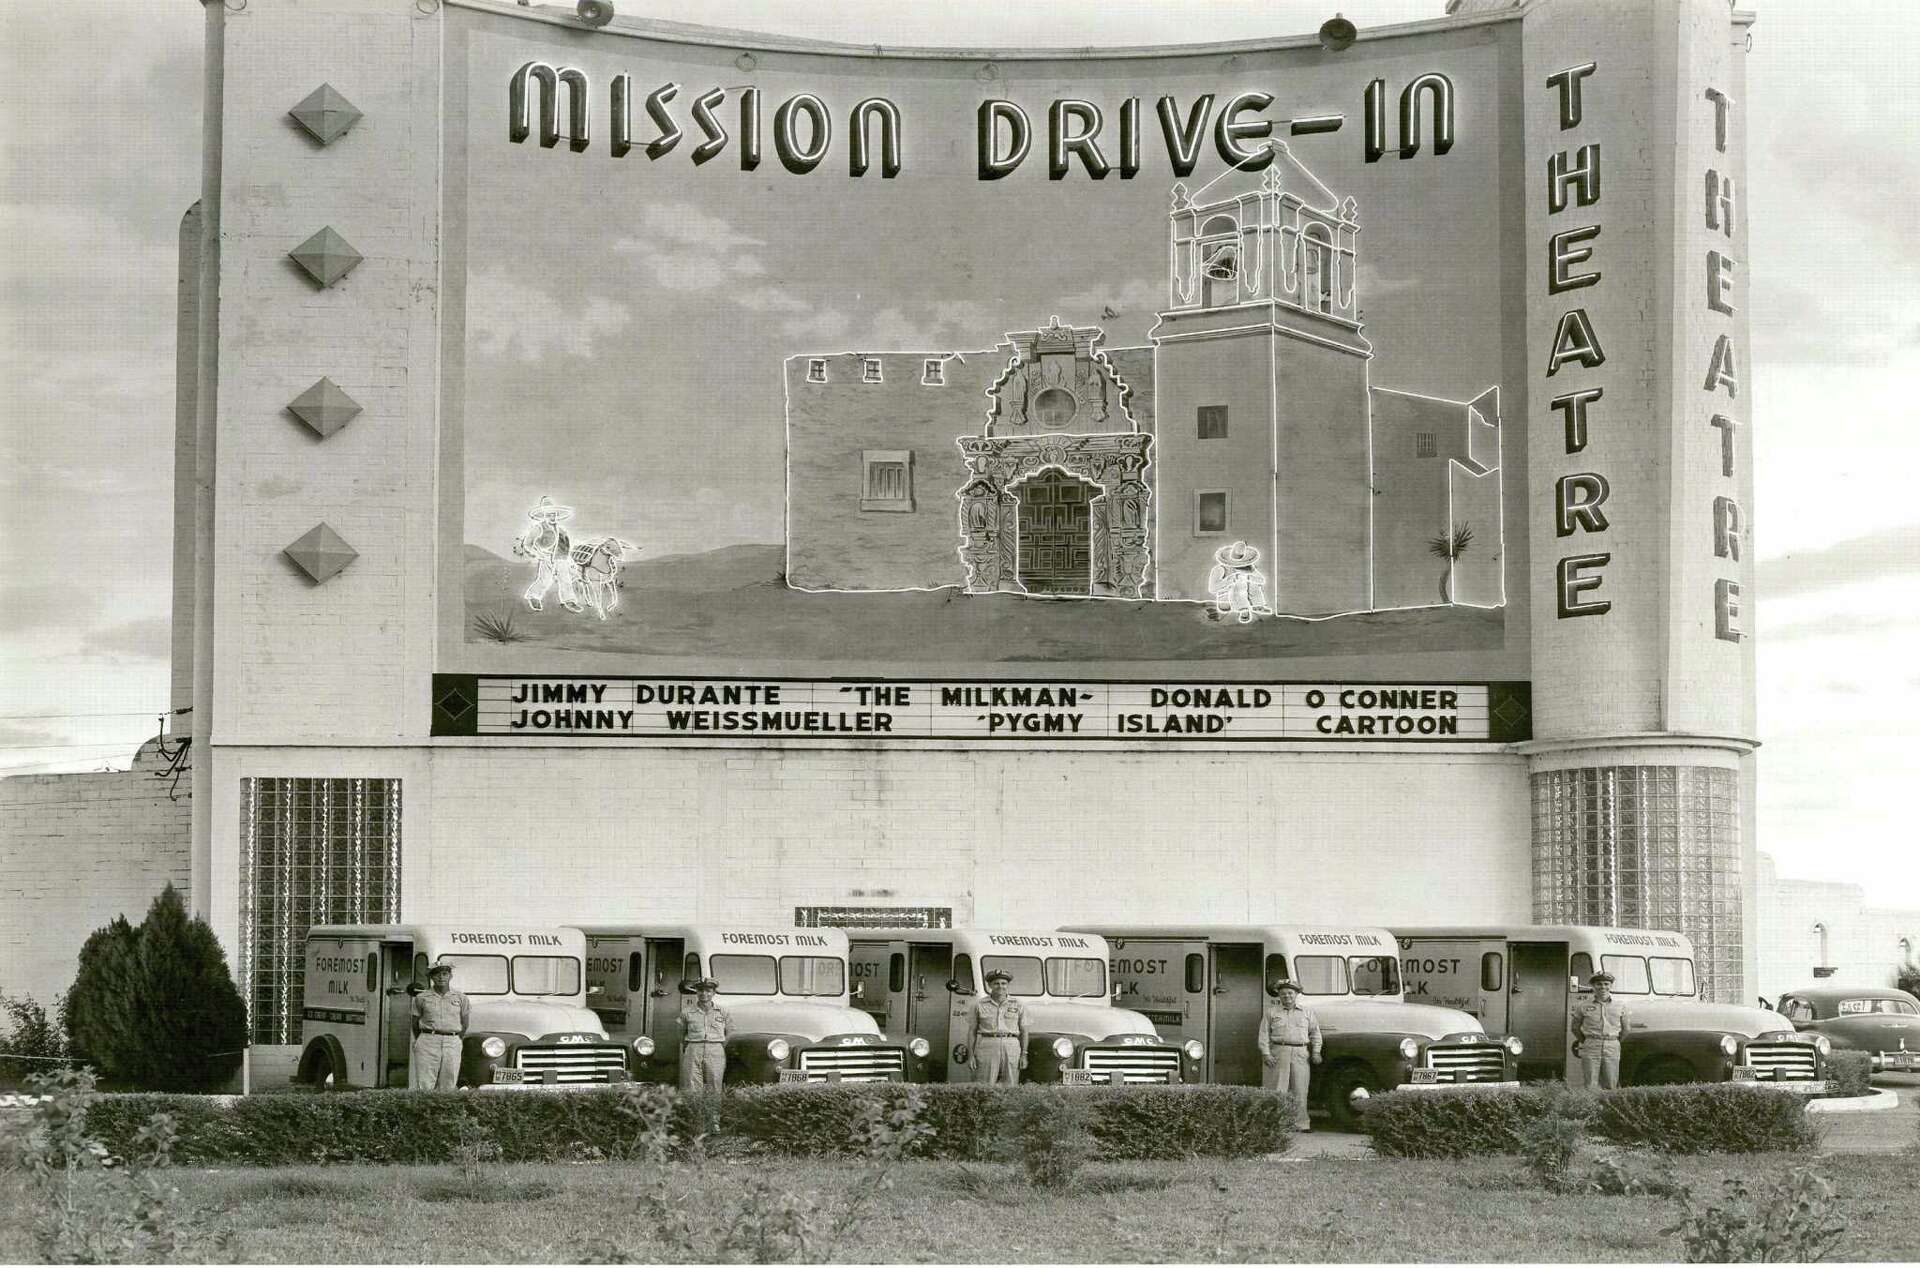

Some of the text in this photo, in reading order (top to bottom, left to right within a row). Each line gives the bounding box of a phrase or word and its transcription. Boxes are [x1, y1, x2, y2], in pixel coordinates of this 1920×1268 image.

[510, 61, 1454, 181] MISSION DRIVE-IN
[1546, 61, 1612, 620] THEATRE
[1702, 87, 1748, 645] THEATRE
[512, 683, 608, 704] JIMMY
[636, 684, 781, 705] DURANTE
[1150, 688, 1272, 708] DONALD
[1305, 689, 1326, 709] O
[1338, 689, 1458, 710] CONNER
[511, 709, 634, 729] JOHNNY
[666, 710, 893, 732] WEISSMUELLER
[1316, 715, 1458, 735] CARTOON
[451, 932, 563, 946] FOREMOST MILK
[721, 932, 829, 946] FOREMOST MILK
[989, 935, 1089, 948] FOREMOST MILK
[1298, 934, 1382, 946] FOREMOST MILK
[315, 957, 365, 973] FOREMOST
[328, 980, 349, 995] MILK
[559, 1034, 594, 1043] GMC
[1123, 1036, 1155, 1046] GMC
